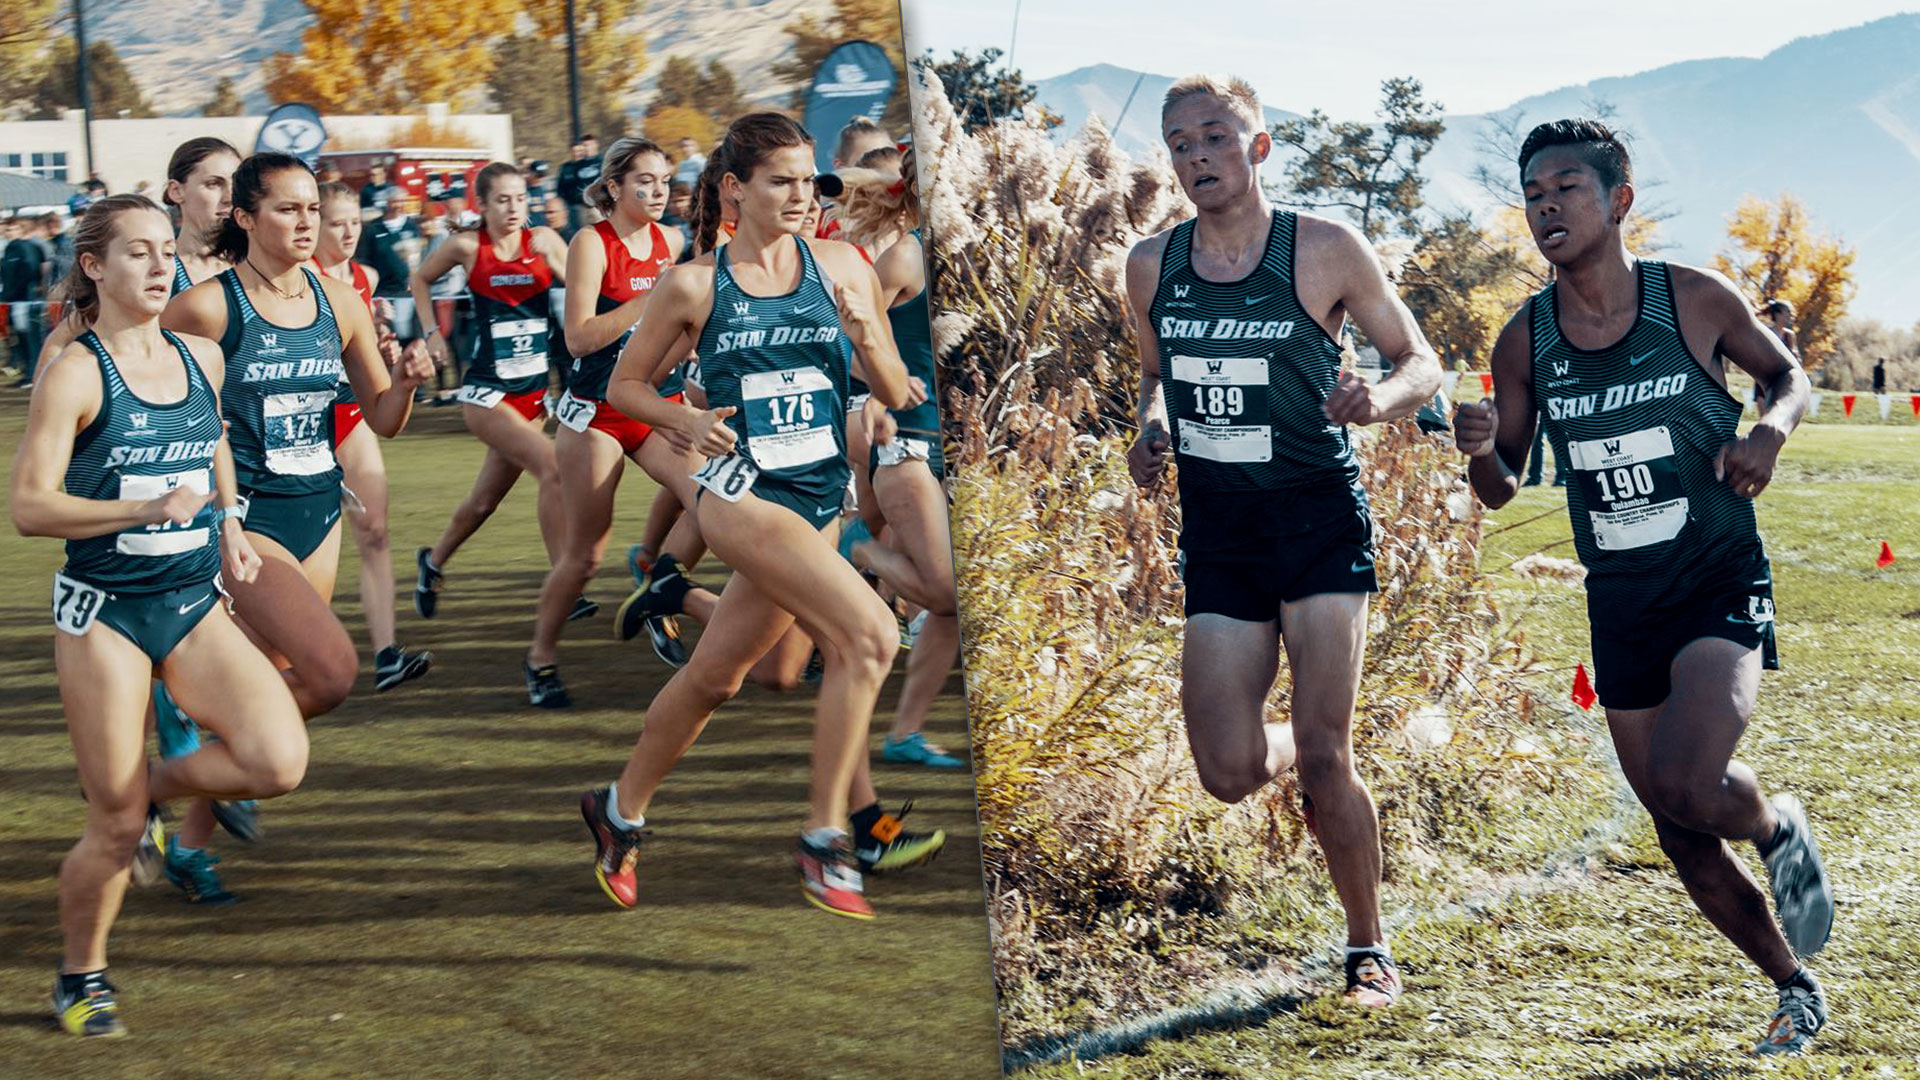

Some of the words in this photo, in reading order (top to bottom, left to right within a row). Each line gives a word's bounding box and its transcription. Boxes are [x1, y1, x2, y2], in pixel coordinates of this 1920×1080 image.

[1160, 316, 1211, 339] SAN
[1211, 318, 1295, 339] DIEGO
[511, 335, 534, 352] 32
[715, 331, 766, 355] SAN
[769, 326, 839, 347] DIEGO
[242, 361, 295, 382] SAN
[296, 357, 341, 378] DIEG
[781, 371, 796, 384] W
[1206, 360, 1223, 373] W
[1552, 360, 1569, 377] W
[1193, 386, 1244, 416] 189
[1547, 393, 1598, 420] SAN
[1601, 373, 1688, 412] DIEGO
[768, 393, 815, 426] 176
[1205, 416, 1231, 425] Pearce
[284, 413, 322, 441] 175
[102, 446, 163, 469] SAN
[161, 440, 217, 462] DIEG
[1603, 440, 1621, 455] W
[165, 475, 179, 489] W
[1596, 464, 1655, 502] 190
[1639, 500, 1681, 514] CHAMPIONSHIPS
[57, 581, 98, 629] 79
